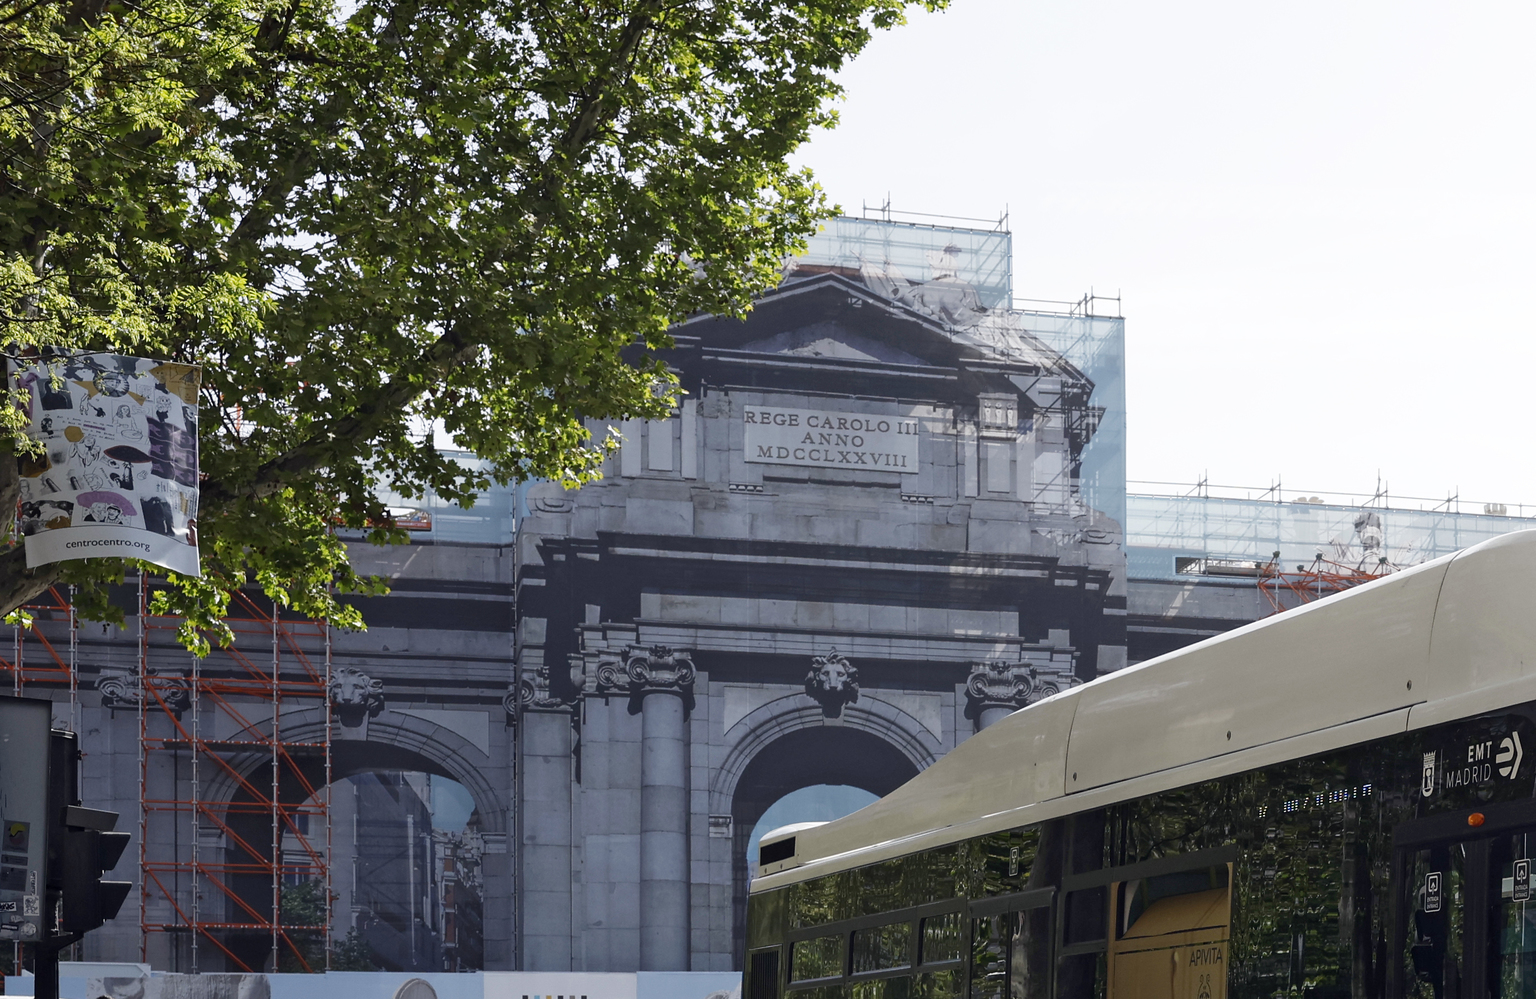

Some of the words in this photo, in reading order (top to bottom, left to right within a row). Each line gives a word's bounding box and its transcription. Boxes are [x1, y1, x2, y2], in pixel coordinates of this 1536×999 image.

[744, 411, 800, 427] REGE
[807, 415, 890, 433] CAROLO
[897, 421, 919, 436] III
[801, 431, 865, 448] ANNO
[757, 445, 907, 468] MDCCLXXVIII
[65, 538, 151, 553] centrocentro.org
[1467, 740, 1493, 763] EMT
[1445, 763, 1492, 789] MADRID
[1189, 947, 1223, 967] APIVITA
